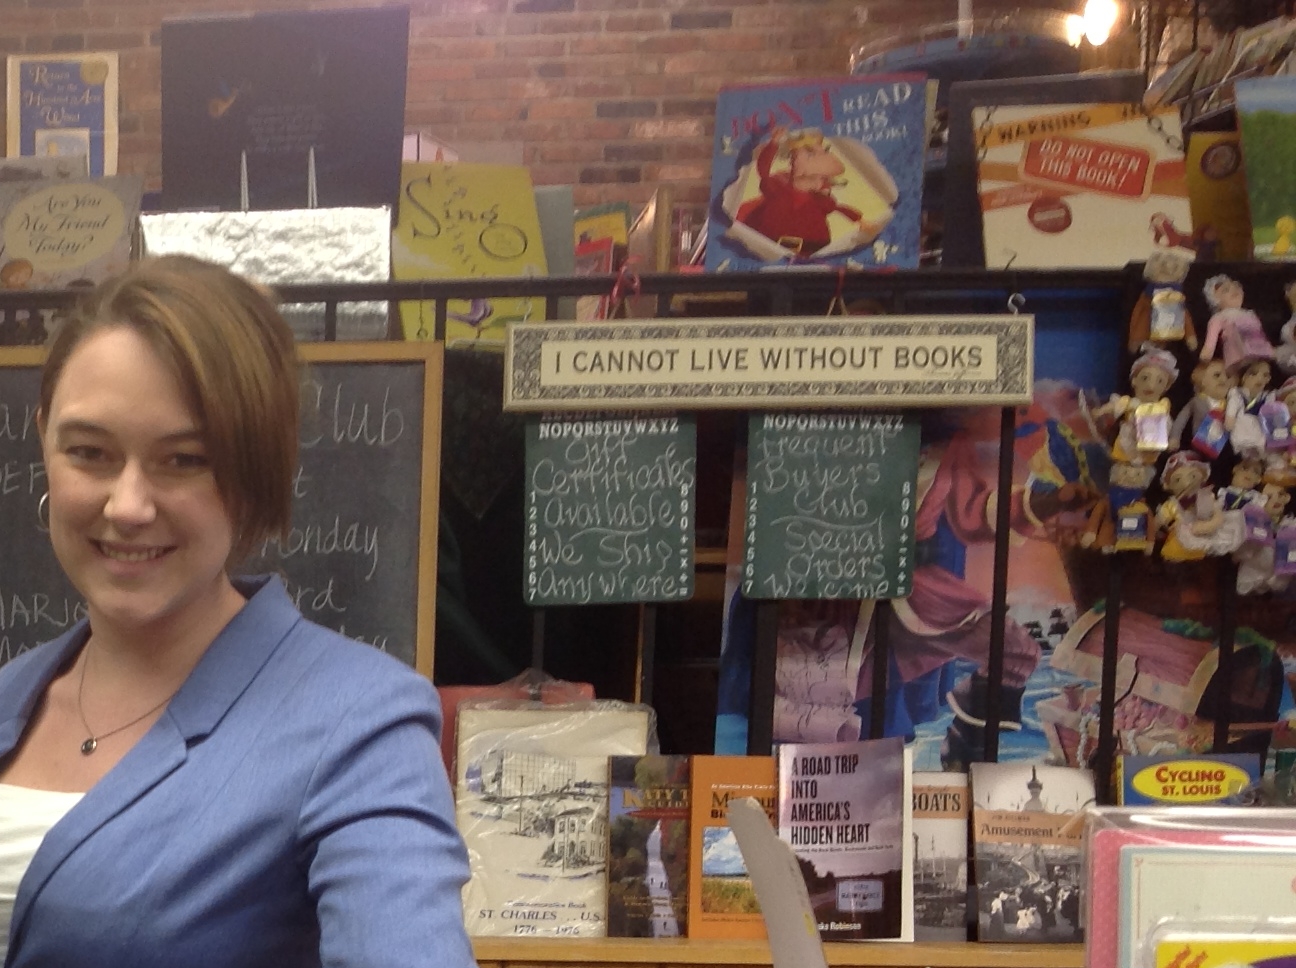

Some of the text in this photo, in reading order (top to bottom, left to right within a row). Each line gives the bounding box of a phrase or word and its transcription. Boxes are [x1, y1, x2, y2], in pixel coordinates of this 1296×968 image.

[842, 82, 912, 114] READ
[997, 110, 1092, 143] WARNING
[1040, 138, 1141, 173] DO NOT OPEN
[1039, 158, 1129, 191] THIS BOOK!
[406, 174, 500, 240] Sing
[554, 343, 984, 374] I CANNOT LIVE WITHOUT BOOKS
[261, 517, 380, 580] Monday
[538, 530, 674, 574] We Ship
[791, 753, 859, 776] A ROAD TRIP
[1155, 765, 1226, 783] CYCLING
[791, 779, 818, 799] INTO
[1162, 784, 1222, 795] ST. LOUIS
[791, 801, 851, 823] AMERICA'S
[791, 823, 871, 846] HIDDEN HEART
[981, 821, 1053, 839] Amusement
[500, 909, 558, 922] CHARLES
